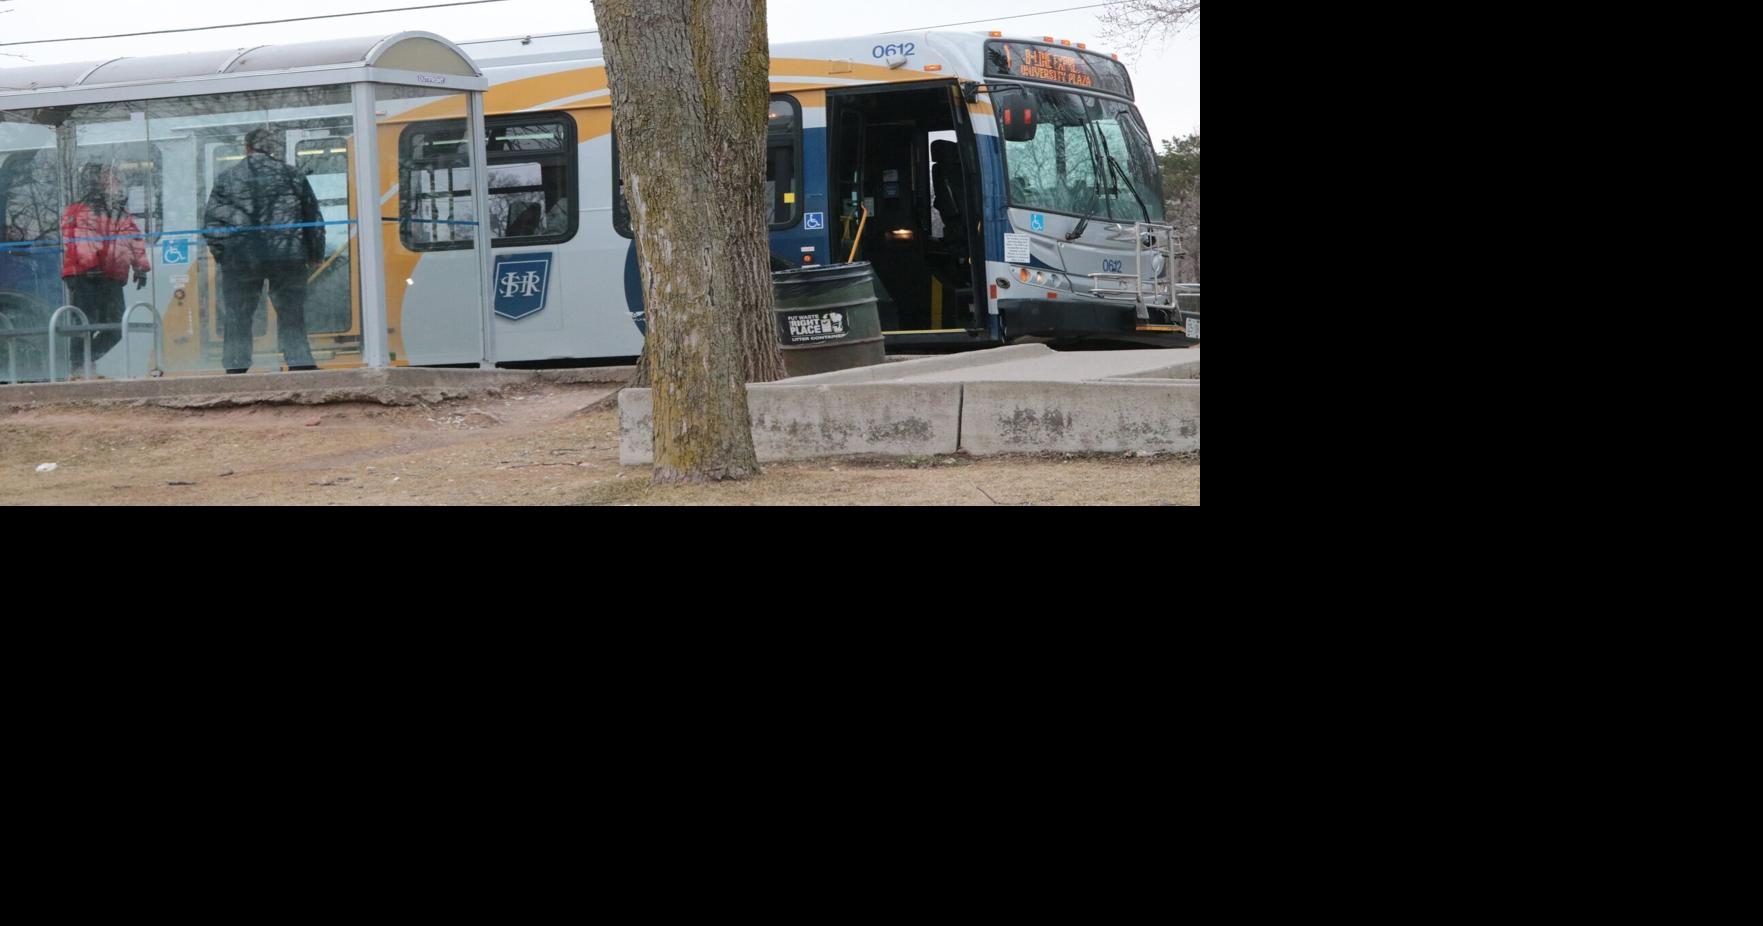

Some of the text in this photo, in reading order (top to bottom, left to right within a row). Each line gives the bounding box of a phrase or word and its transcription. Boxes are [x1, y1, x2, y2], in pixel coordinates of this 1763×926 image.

[872, 42, 915, 59] 0612
[791, 319, 820, 327] RIGHT
[790, 325, 822, 335] PLACE
